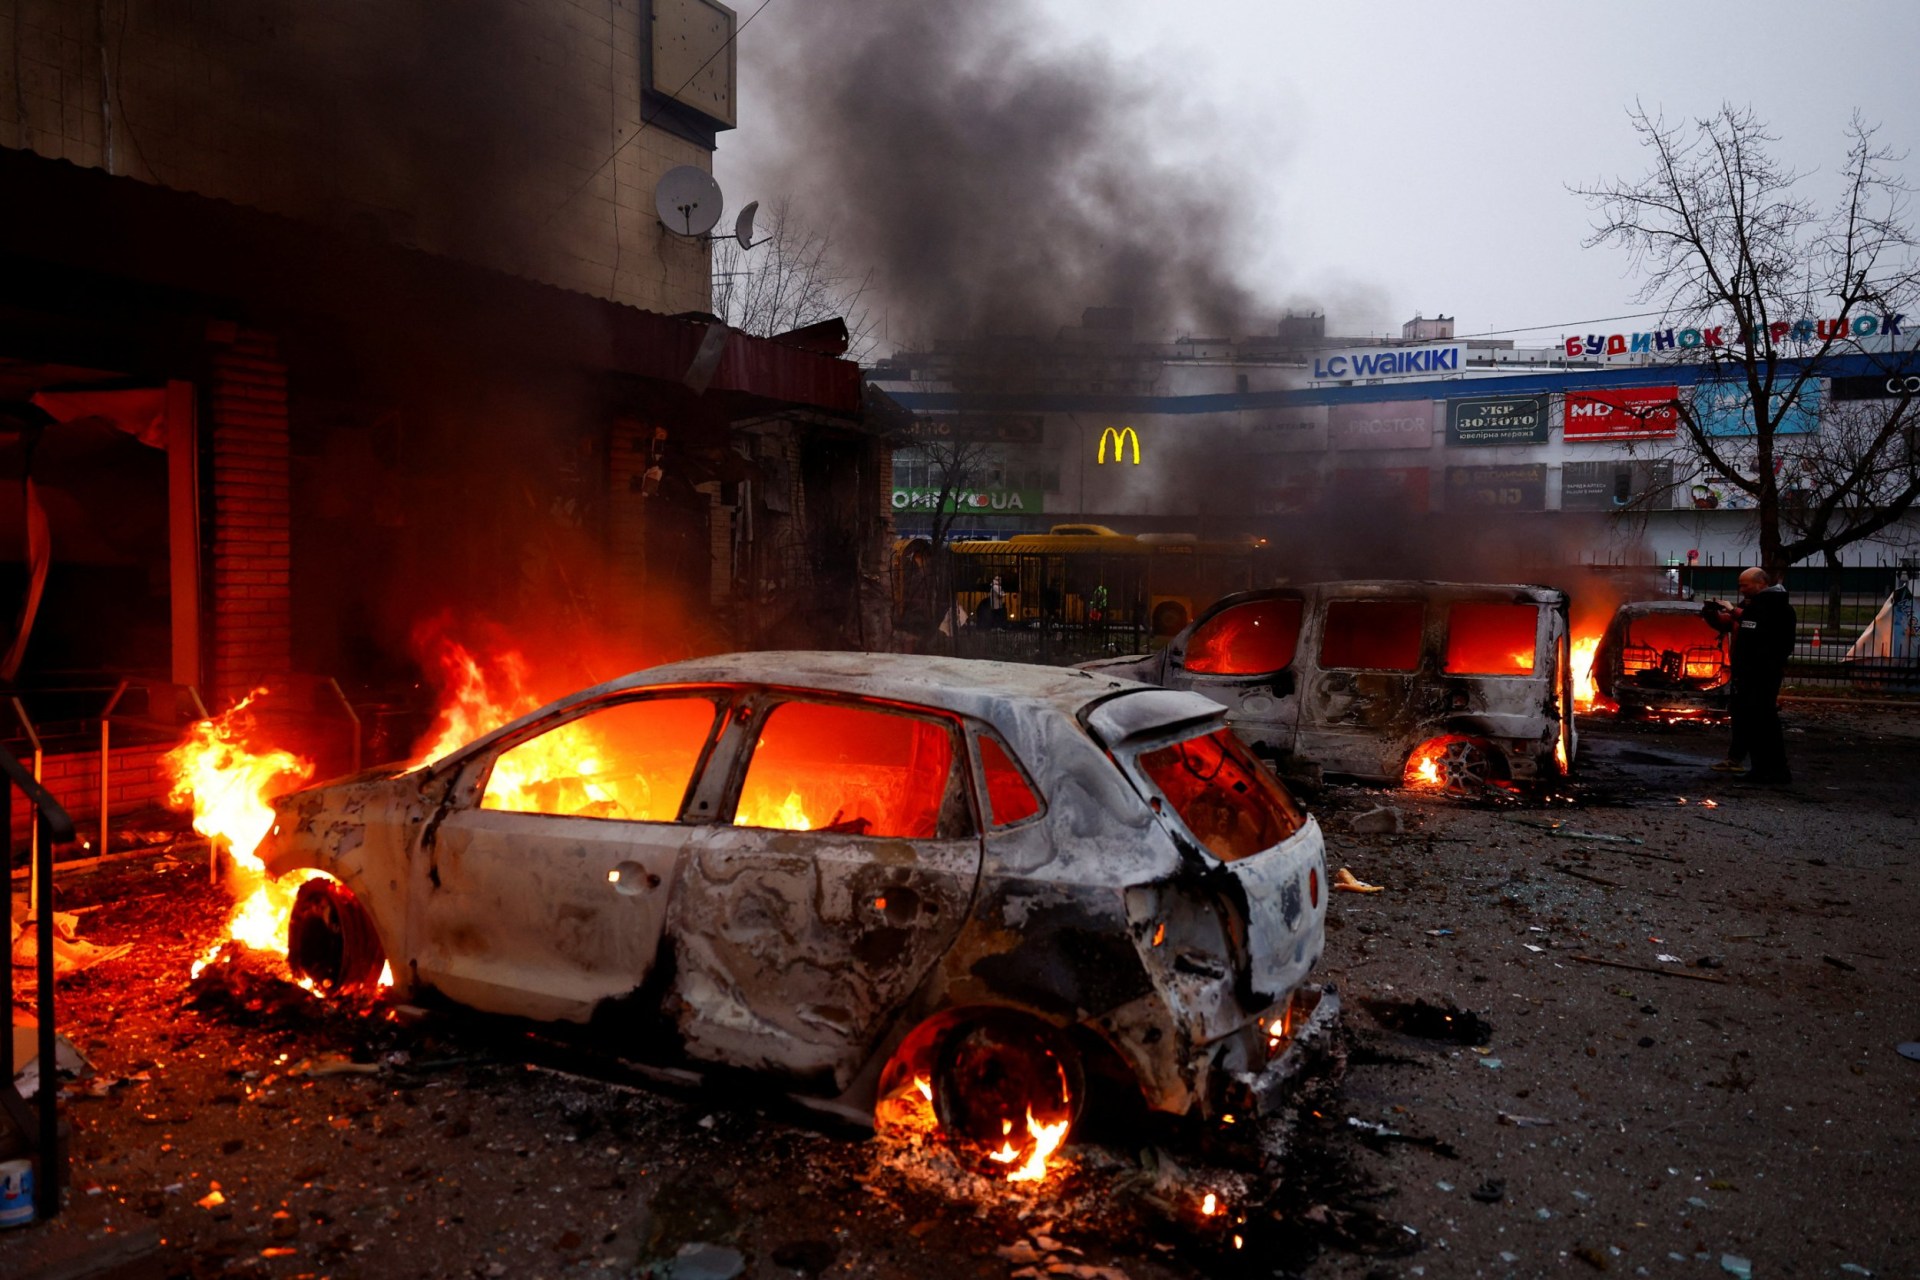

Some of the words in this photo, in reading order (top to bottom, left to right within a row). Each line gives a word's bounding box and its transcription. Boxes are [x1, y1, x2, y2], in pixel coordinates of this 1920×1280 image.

[1565, 325, 1724, 357] БУДИНОК
[1314, 356, 1347, 378] LC
[1480, 405, 1514, 416] УКР
[1571, 402, 1613, 417] MD
[1349, 417, 1426, 434] PROSTOR
[1460, 415, 1535, 428] ЗОЛОТО
[1459, 431, 1499, 440] ювелірна
[1500, 430, 1534, 439] мережа
[991, 492, 1024, 509] UA
